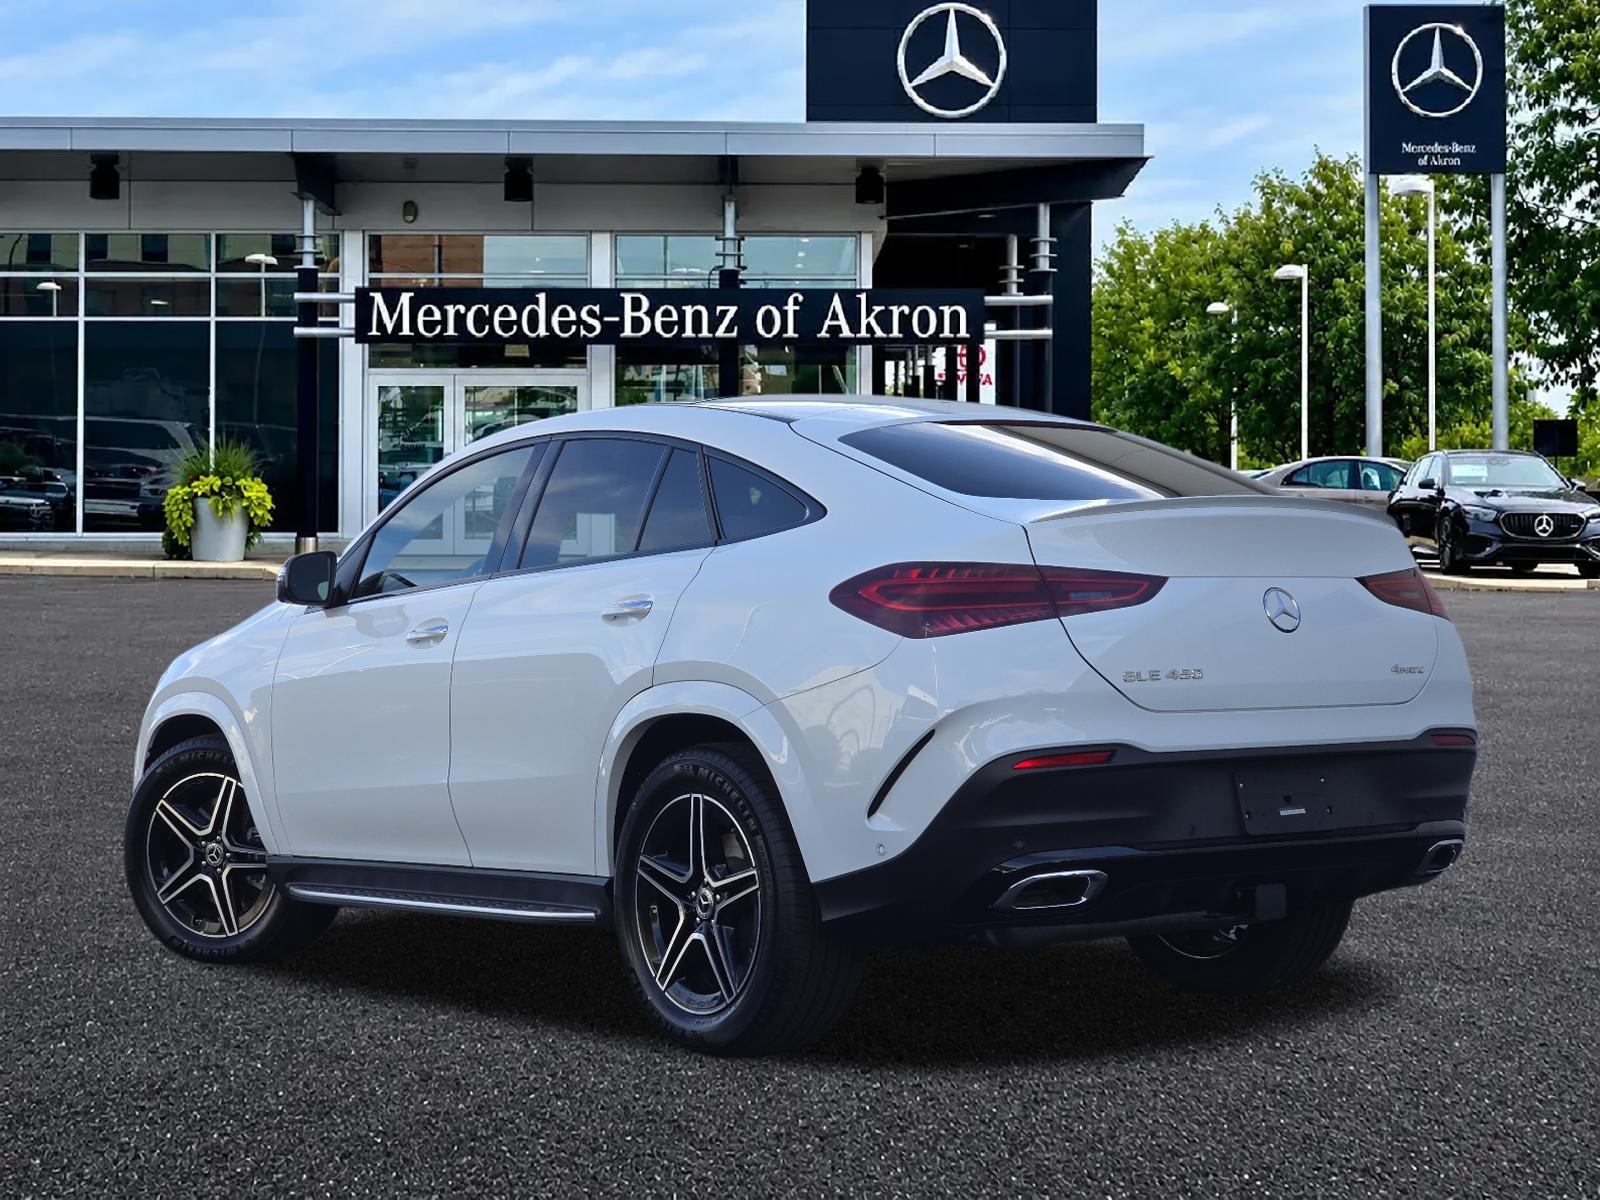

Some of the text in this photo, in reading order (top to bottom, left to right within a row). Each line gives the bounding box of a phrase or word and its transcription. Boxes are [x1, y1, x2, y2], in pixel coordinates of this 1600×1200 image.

[1401, 142, 1476, 153] Mercedes-Benz
[1417, 154, 1461, 166] of Akron
[367, 291, 971, 339] Mercedes-Benz of Akron
[1123, 668, 1204, 682] GLE 450
